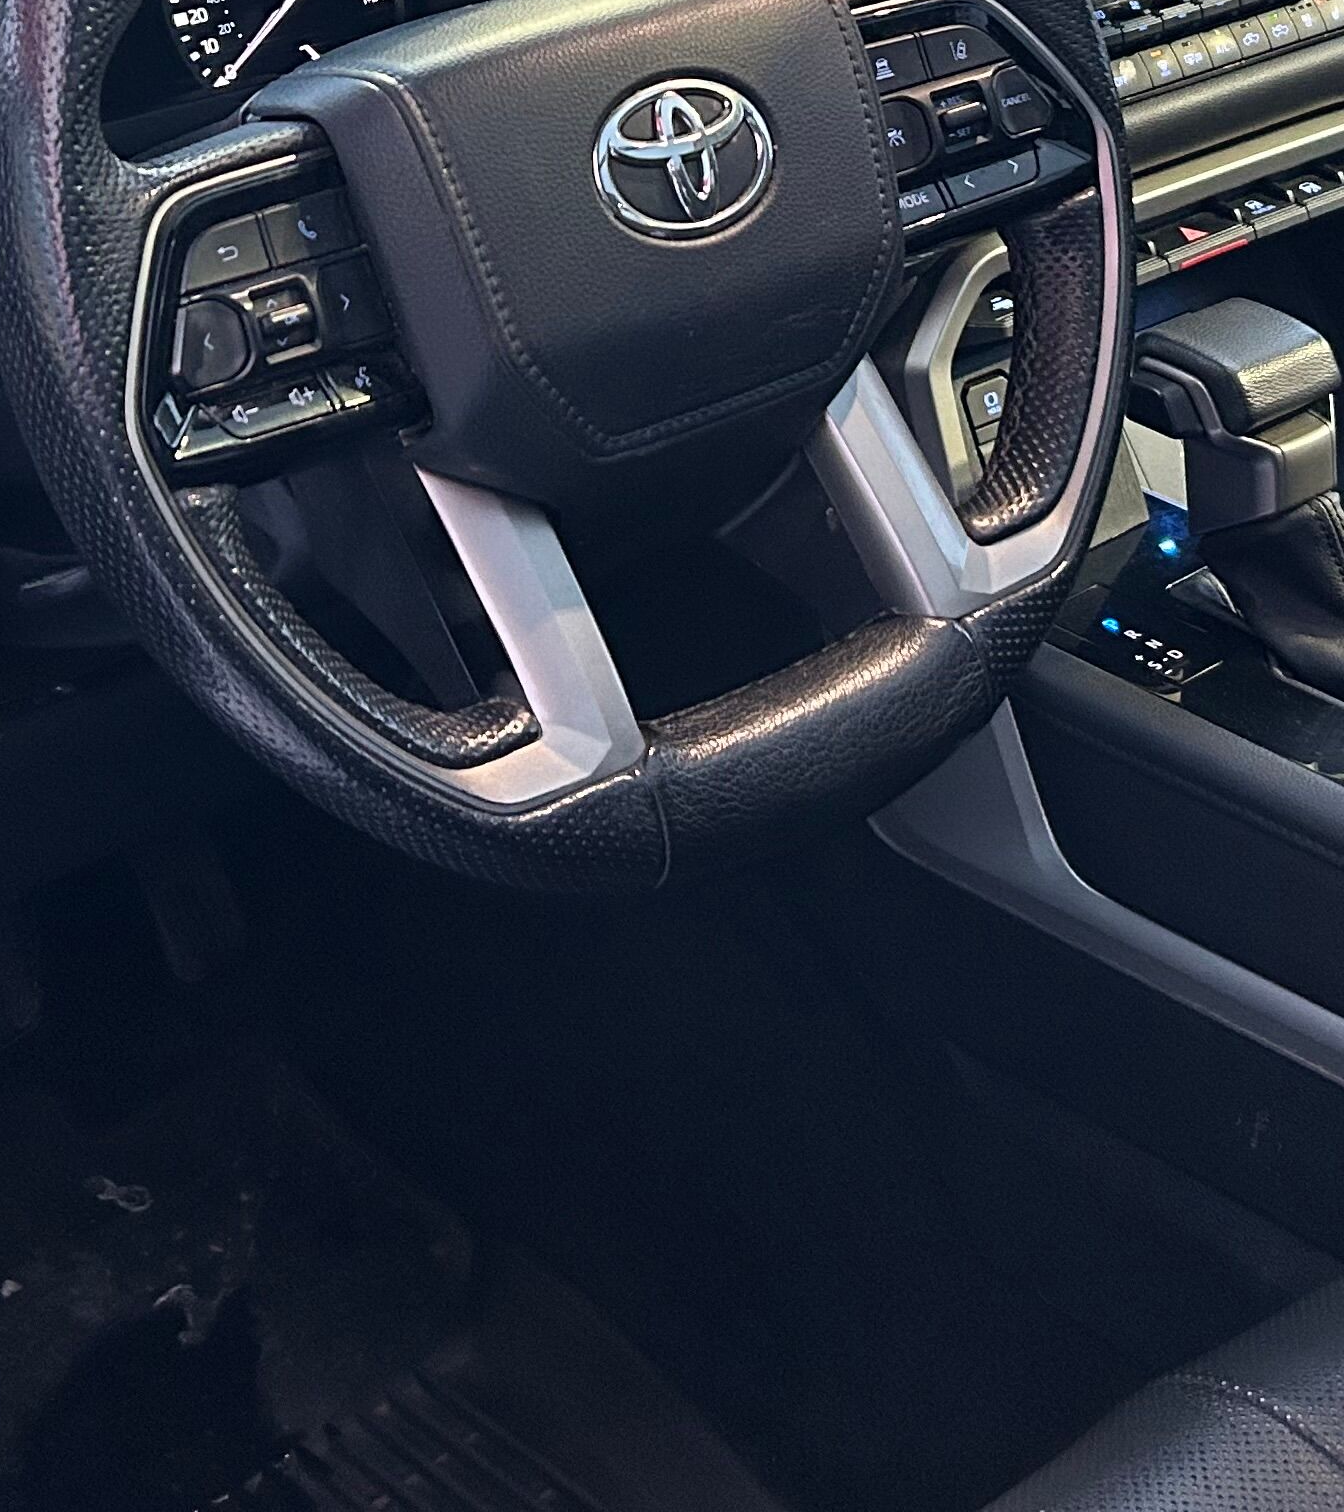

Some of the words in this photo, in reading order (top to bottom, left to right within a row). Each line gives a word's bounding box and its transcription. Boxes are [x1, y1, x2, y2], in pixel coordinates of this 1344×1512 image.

[188, 8, 209, 25] 20
[218, 23, 232, 35] 20
[200, 38, 220, 54] 10
[1001, 93, 1031, 108] CANCEL
[1124, 630, 1142, 639] R
[1145, 639, 1163, 649] N
[1166, 650, 1183, 659] D
